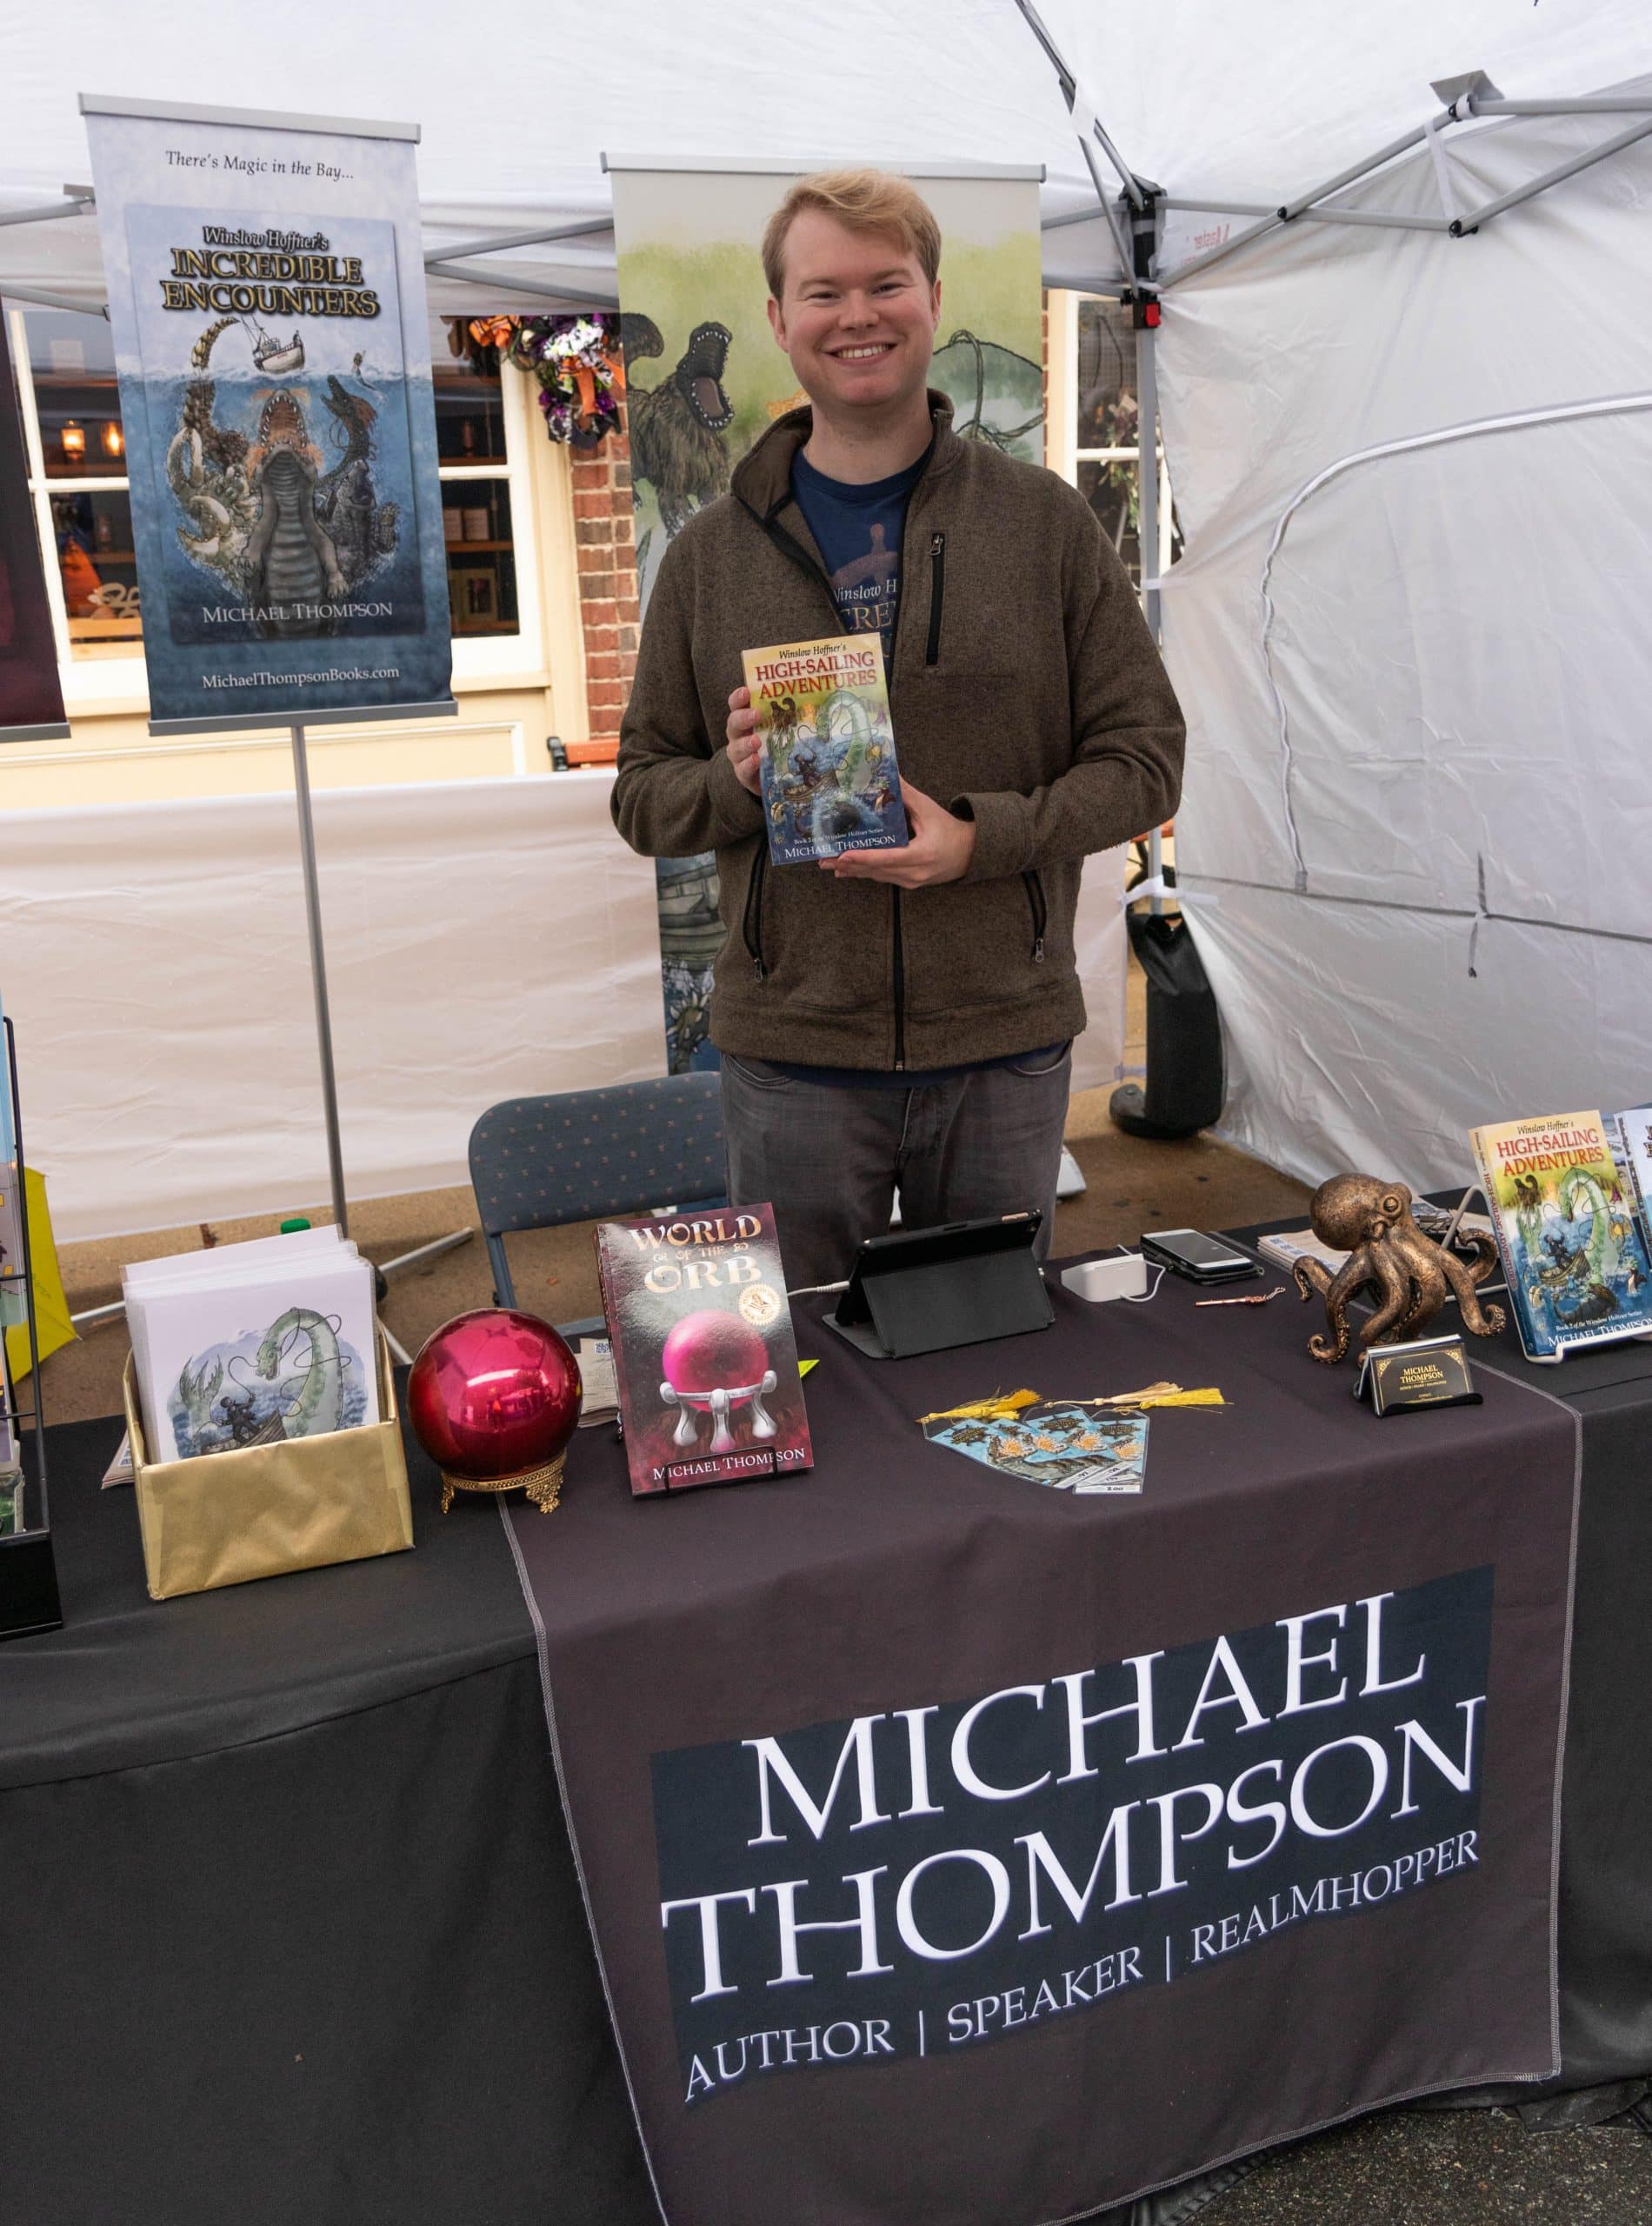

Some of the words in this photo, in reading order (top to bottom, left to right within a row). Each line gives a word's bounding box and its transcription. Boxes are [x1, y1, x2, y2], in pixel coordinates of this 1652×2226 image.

[165, 150, 218, 168] There's
[223, 155, 268, 175] Magic
[272, 158, 286, 174] in
[291, 160, 311, 176] the
[316, 163, 354, 182] Bay...
[203, 226, 264, 247] Winslow
[267, 230, 329, 253] Hoffner's
[171, 248, 364, 285] INCREDIBLE
[160, 280, 380, 317] ENCOUNTERS
[203, 607, 290, 623] MICHAEL
[292, 603, 393, 620] THOMPSON
[779, 650, 811, 659] Winslow
[813, 643, 847, 656] Hoffner's
[202, 667, 400, 689] MichaelThompsonBooks.com
[755, 651, 875, 681] HIGH-SAILING
[759, 669, 877, 699] ADVENTURES
[784, 844, 834, 859] MICHAEL
[835, 835, 896, 851] THOMPSON
[1517, 1124, 1545, 1135] Winslow
[1547, 1120, 1574, 1132] Hoffner's
[1496, 1130, 1598, 1156] HIGH-SAILING
[1503, 1146, 1604, 1176] ADVENTURES
[628, 1215, 762, 1251] WORLD
[676, 1250, 692, 1260] OF
[699, 1245, 725, 1257] THE
[644, 1256, 762, 1293] ORB
[1547, 1330, 1594, 1347] MICHAEL
[1400, 1370, 1443, 1383] THOMPSON
[1403, 1363, 1438, 1376] MICHAEL
[653, 1461, 721, 1480] MICHAEL
[742, 1592, 1424, 1846] MICHAEL
[661, 1696, 1486, 2003] THOMPSON
[684, 2018, 893, 2103] AUTHOR
[947, 1945, 1144, 2044] SPEAKER
[1190, 1829, 1481, 1962] REALMHOPPER
